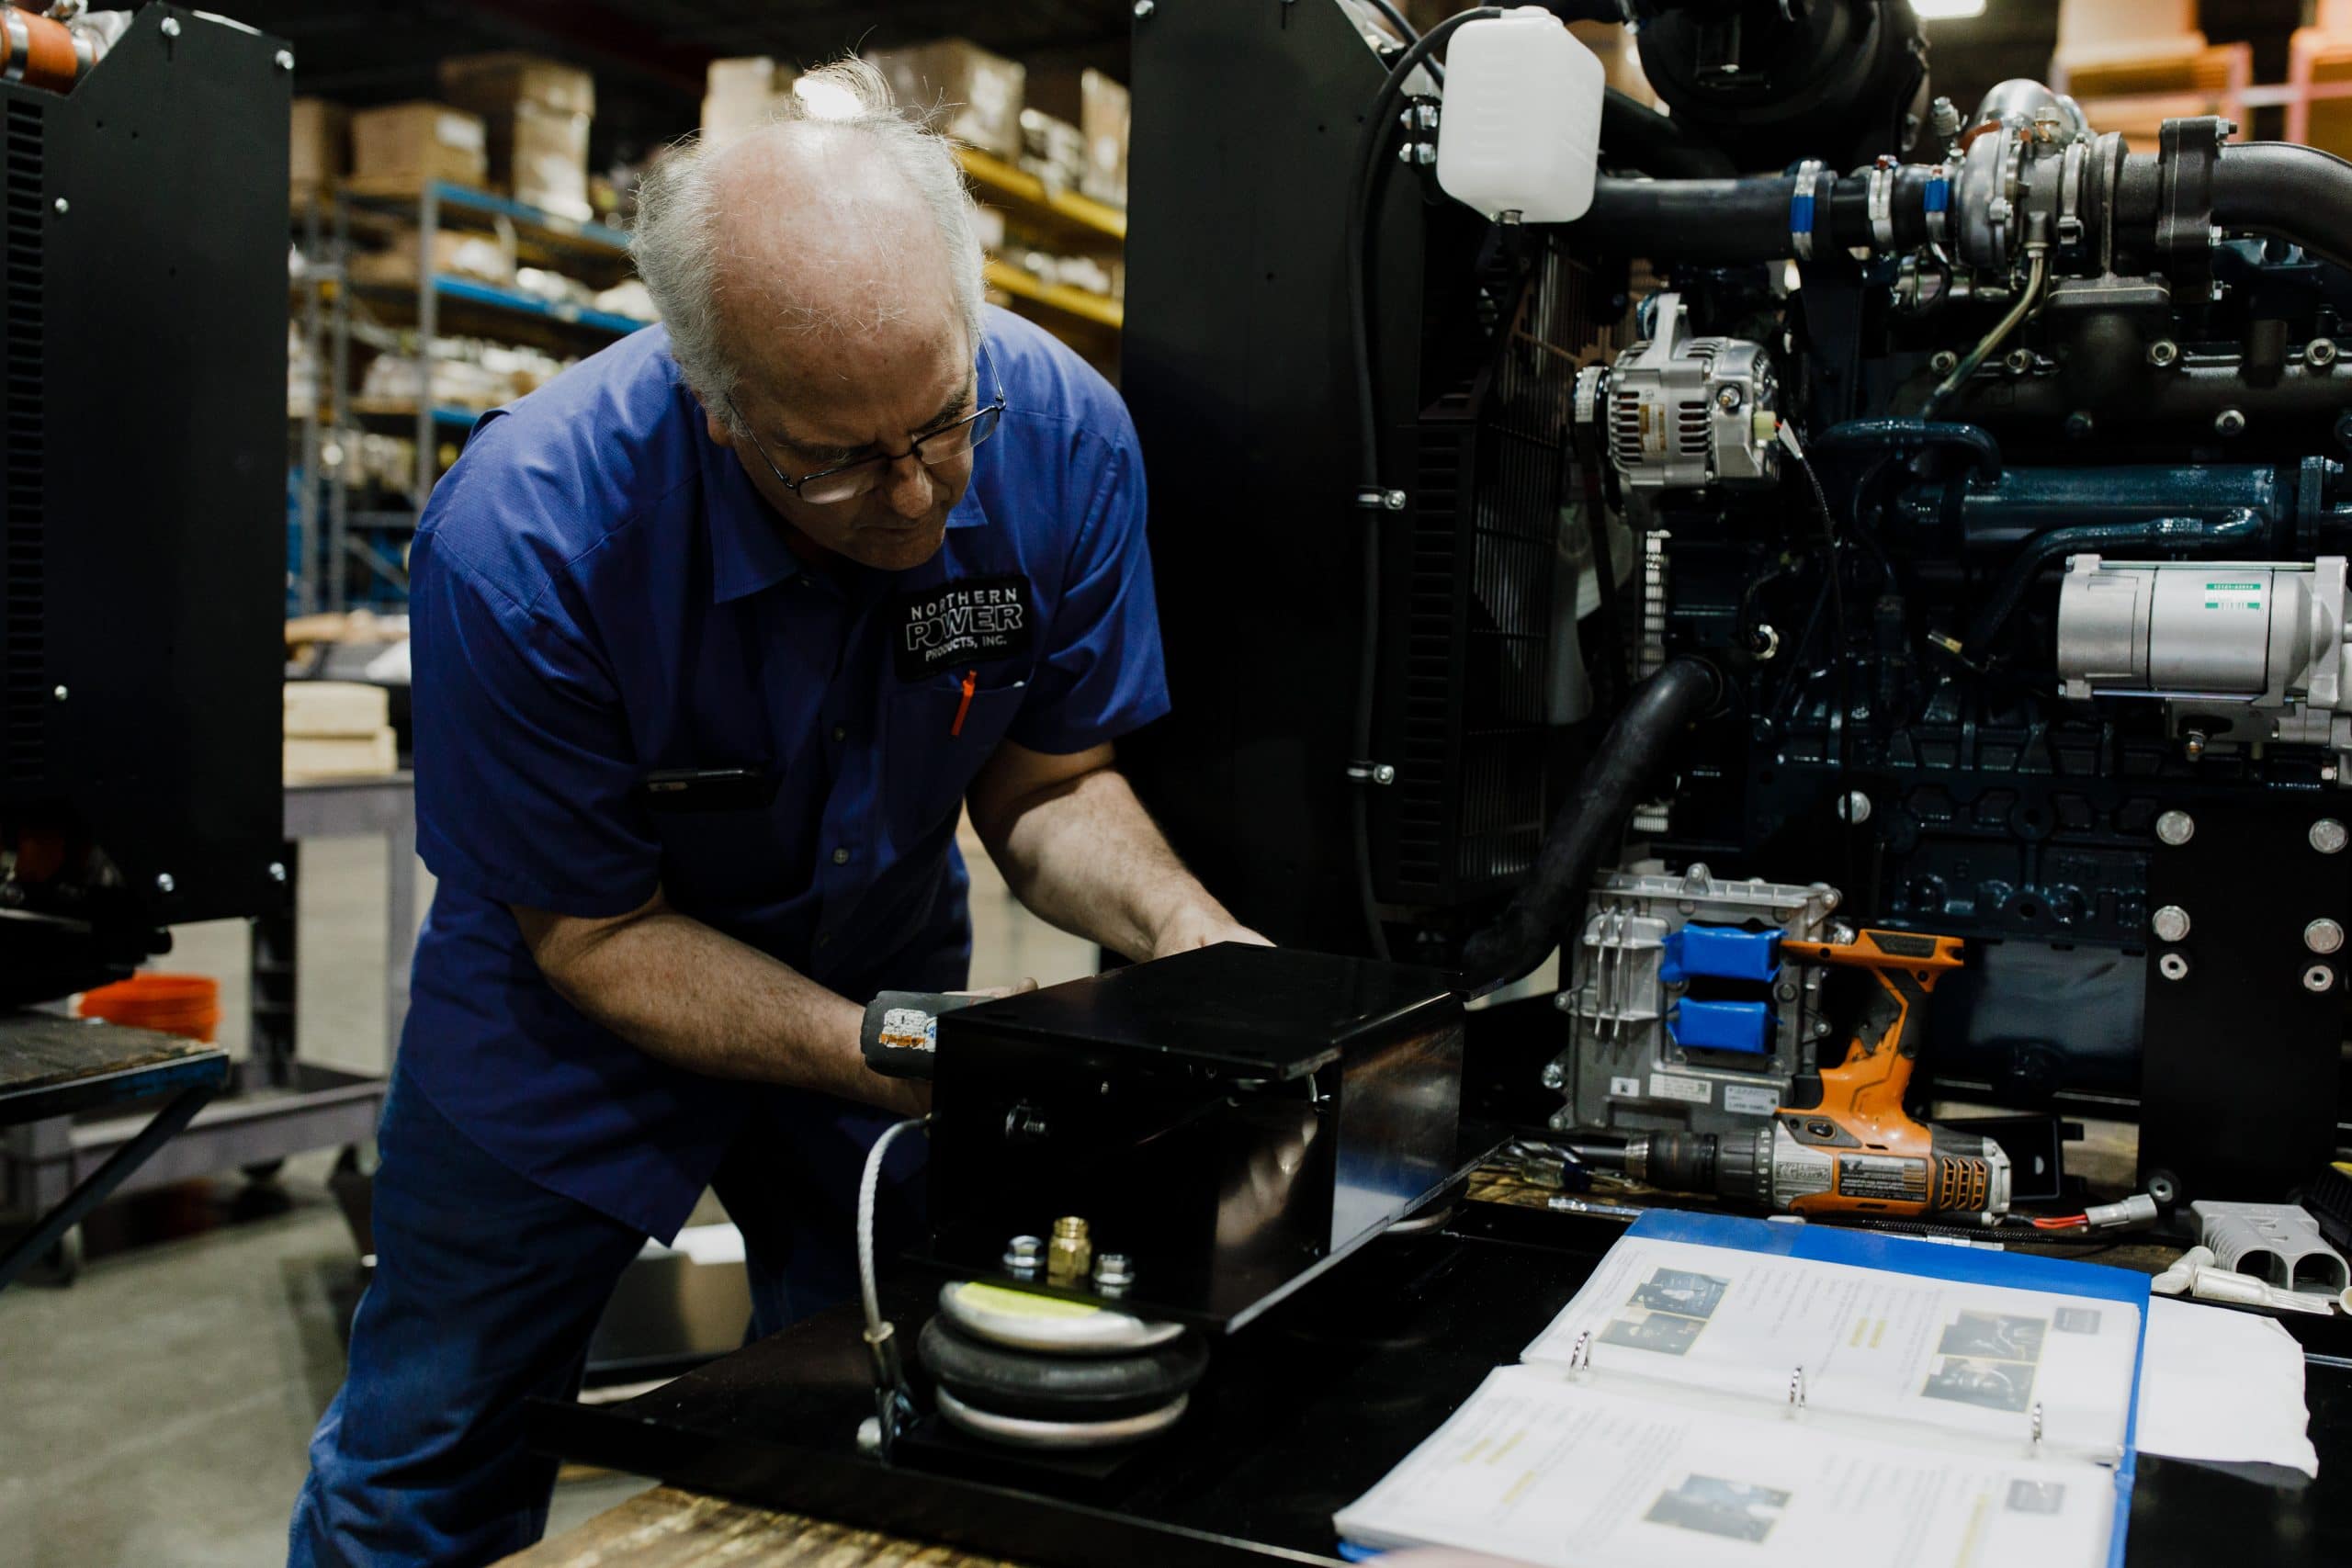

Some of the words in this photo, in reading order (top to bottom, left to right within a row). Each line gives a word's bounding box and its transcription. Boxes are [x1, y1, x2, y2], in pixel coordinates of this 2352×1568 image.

[910, 588, 1017, 621] NORTHERN
[906, 604, 1023, 651] POWER
[925, 636, 978, 661] PRODUCTS,
[982, 635, 1007, 647] INC.
